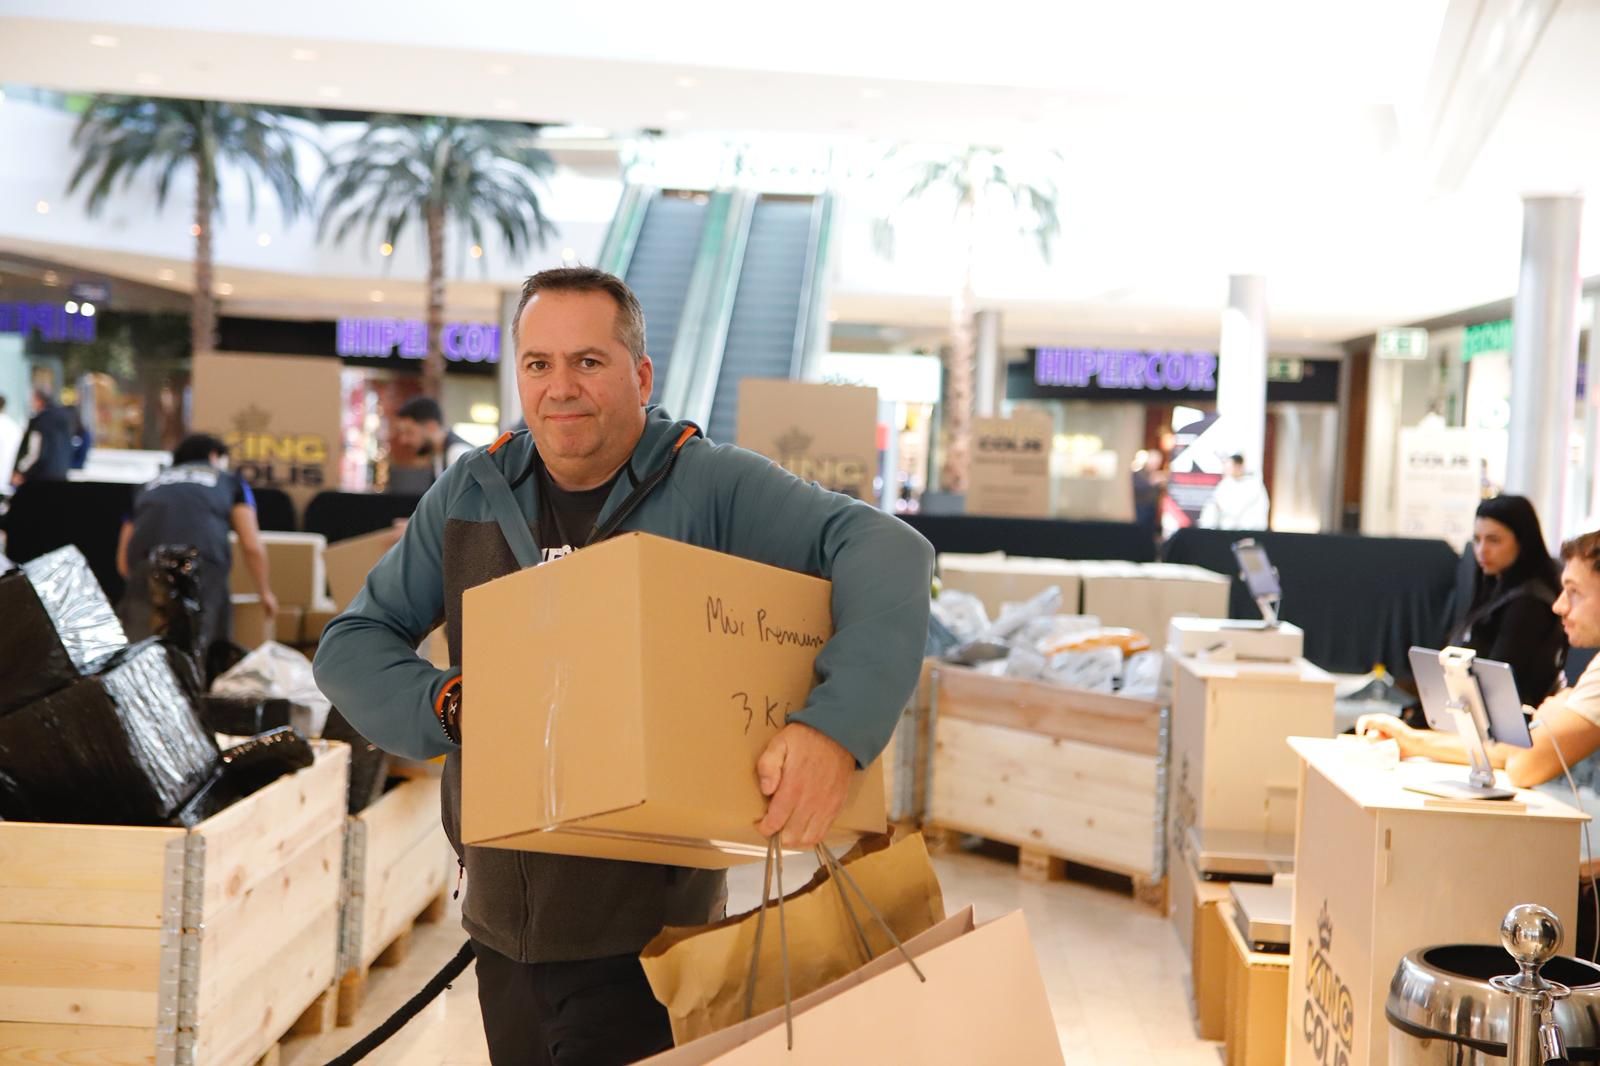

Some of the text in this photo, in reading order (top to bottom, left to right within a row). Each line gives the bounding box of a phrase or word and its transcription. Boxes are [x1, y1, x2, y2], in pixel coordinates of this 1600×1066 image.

[1035, 347, 1217, 391] HIPERCOR
[237, 463, 326, 487] OLIS
[731, 692, 753, 735] 3
[1306, 938, 1353, 1053] KING
